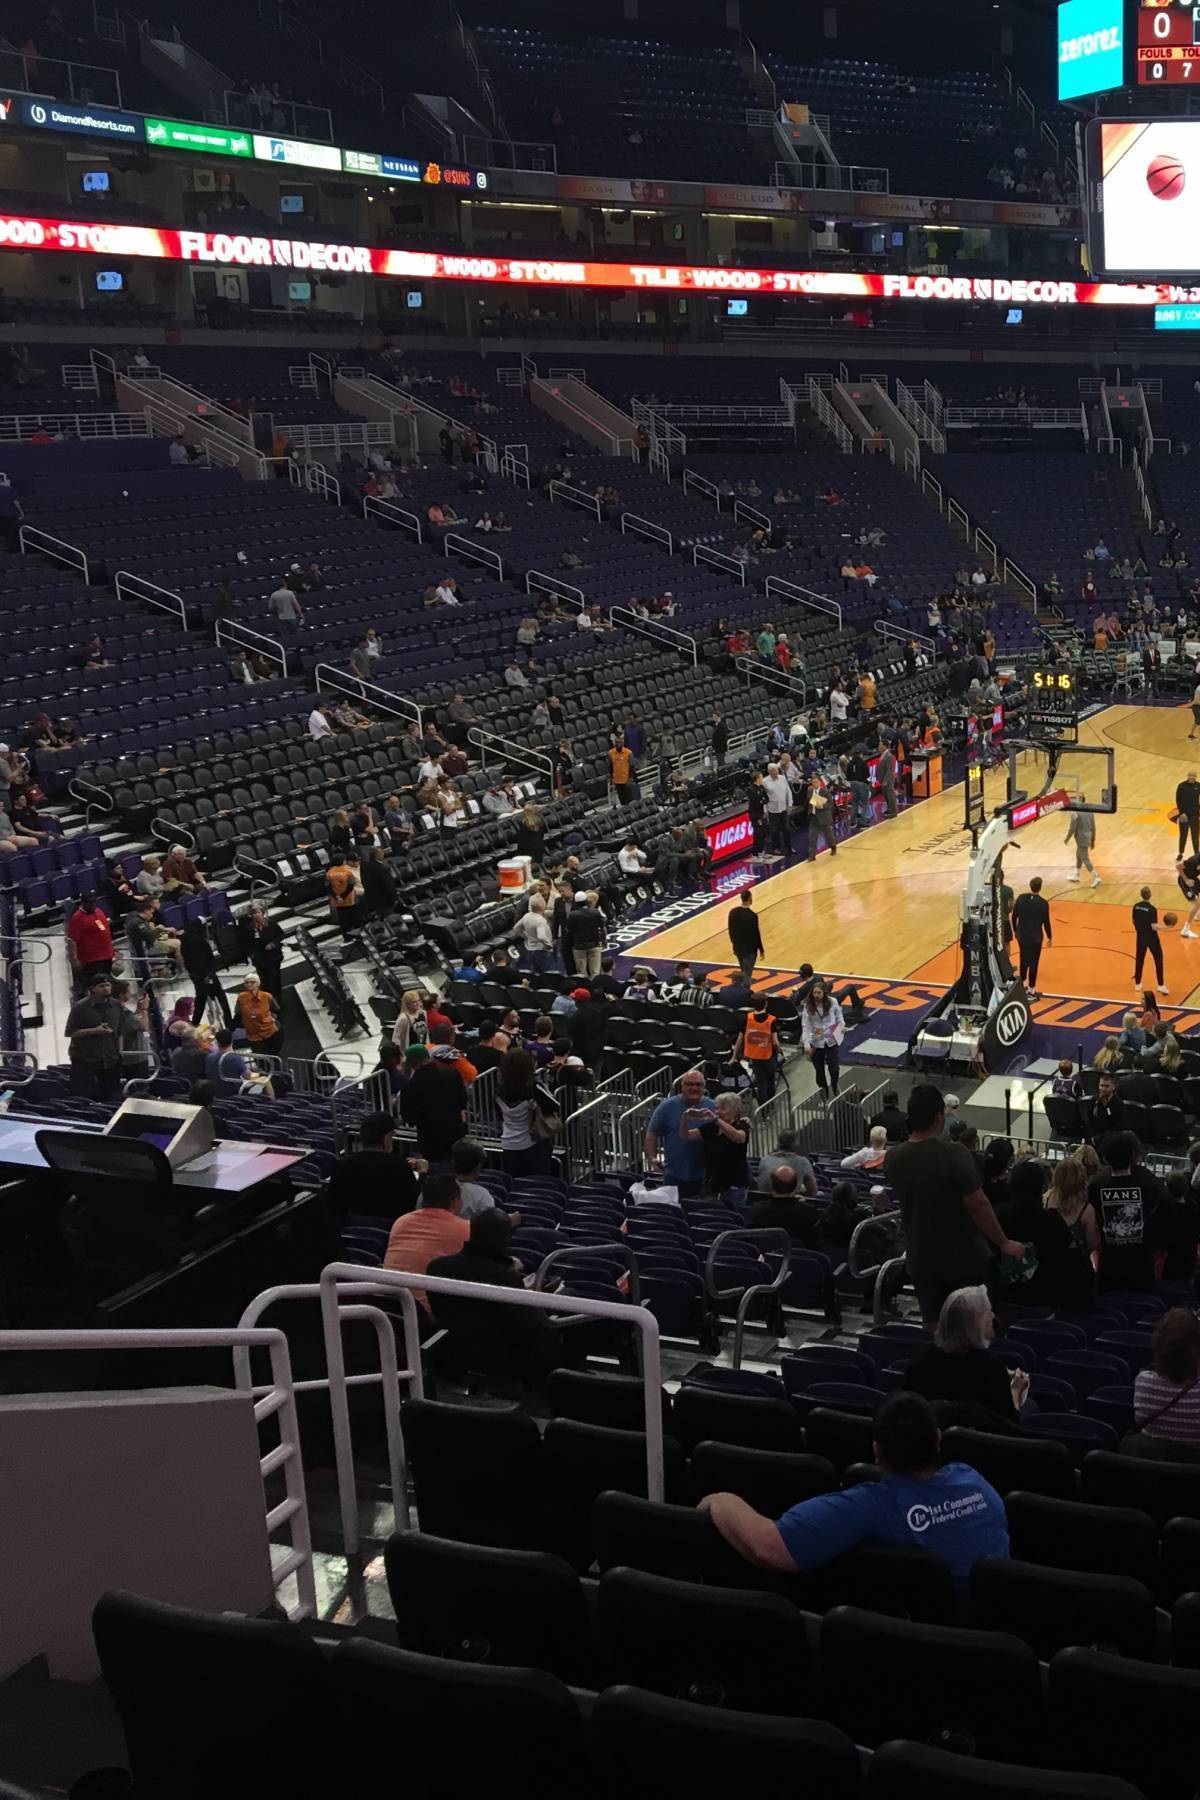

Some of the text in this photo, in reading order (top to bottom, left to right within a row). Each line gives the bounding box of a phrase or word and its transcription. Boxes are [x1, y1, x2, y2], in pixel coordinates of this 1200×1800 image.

[1153, 12, 1171, 38] 0
[1060, 26, 1120, 62] zerorez
[1139, 48, 1173, 59] FOULS
[1152, 62, 1192, 79] 0 7
[52, 111, 135, 133] DiamondResorts.com
[444, 169, 471, 186] @SUNS
[180, 231, 272, 265] FLOOR
[291, 241, 373, 272] DECOR
[443, 257, 497, 278] WOOD
[630, 267, 679, 286] TILE
[692, 269, 761, 289] WOOD
[884, 276, 971, 299] FLOOR
[994, 280, 1076, 302] DECOR
[1042, 715, 1074, 725] TISSOT
[715, 822, 746, 850] LUCAS
[607, 874, 760, 942] annexus.com
[1000, 1007, 1025, 1041] KIA
[1103, 1190, 1139, 1200] VANS
